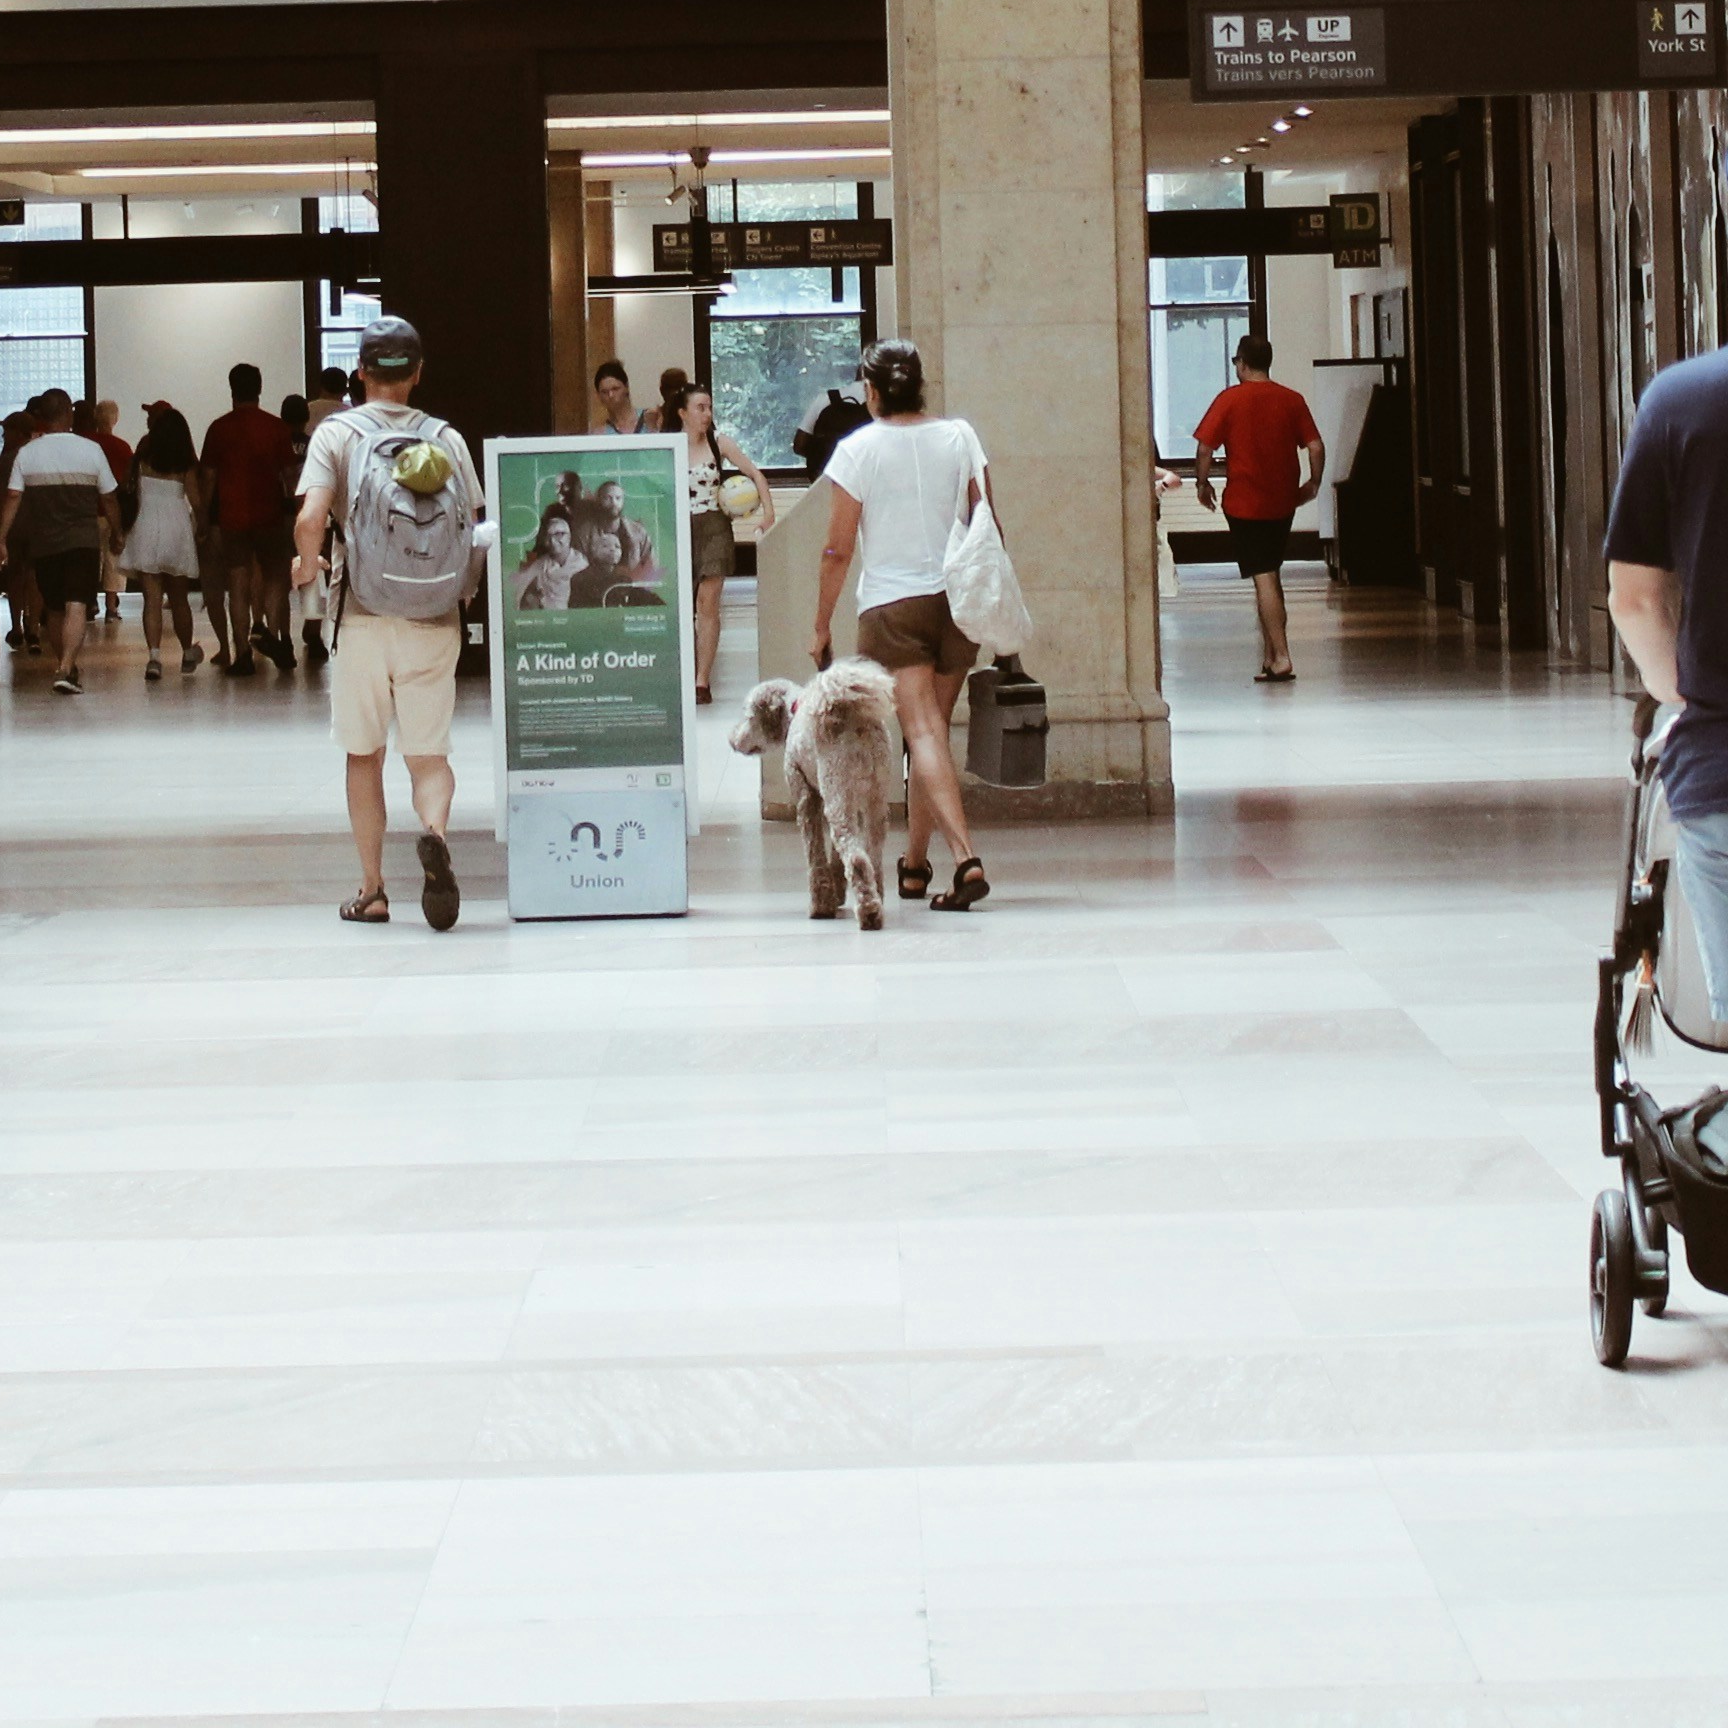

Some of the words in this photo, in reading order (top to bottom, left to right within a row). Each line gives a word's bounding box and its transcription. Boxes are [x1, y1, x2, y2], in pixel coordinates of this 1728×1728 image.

[1317, 19, 1340, 33] UP
[1649, 38, 1685, 53] York
[1690, 37, 1706, 52] St
[1215, 50, 1264, 65] Trains
[1268, 49, 1285, 63] to
[1290, 47, 1357, 63] Pearson
[1215, 68, 1264, 83] Trains
[1269, 69, 1304, 81] vers
[1308, 65, 1375, 80] Pearson
[1336, 203, 1376, 231] TD
[1338, 250, 1376, 264] ATM
[517, 655, 530, 672] A
[535, 652, 576, 671] Kind
[580, 650, 600, 669] of
[604, 649, 657, 669] Order
[568, 675, 579, 685] by
[581, 674, 595, 684] TD
[570, 874, 625, 889] Union
